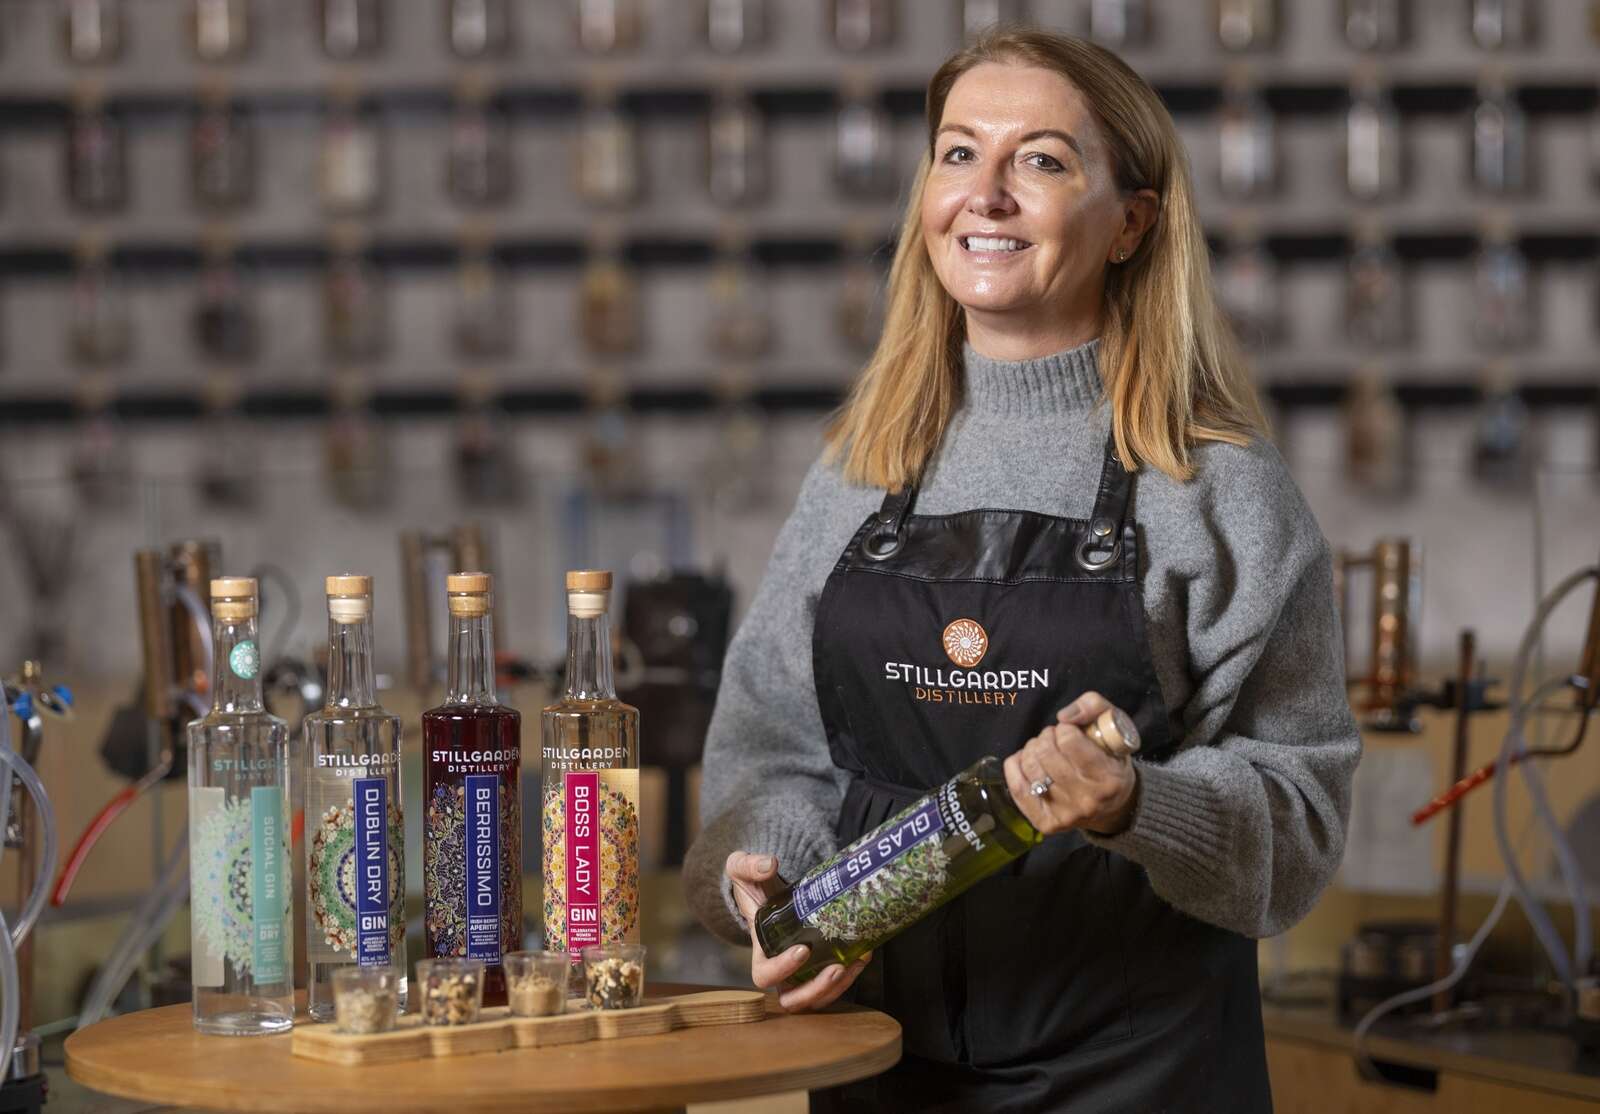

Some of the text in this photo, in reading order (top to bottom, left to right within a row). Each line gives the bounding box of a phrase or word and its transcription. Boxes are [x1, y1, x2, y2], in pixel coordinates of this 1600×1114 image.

[885, 662, 1049, 689] STILLGARDEN
[915, 687, 1018, 705] DISTILLERY
[318, 752, 400, 767] STILLGARD
[542, 747, 631, 759] STILLGARDEN
[448, 764, 510, 773] DISTILLERY
[551, 761, 612, 769] DISTILLERY
[365, 789, 382, 904] DUBLIN DRY
[476, 788, 492, 906] BERRISSIMO
[575, 786, 591, 895] BOSS LADY
[846, 812, 930, 878] GLAS 55
[264, 816, 275, 899] SOCIAL GIN
[362, 916, 387, 930] GIN
[571, 908, 597, 921] GIN
